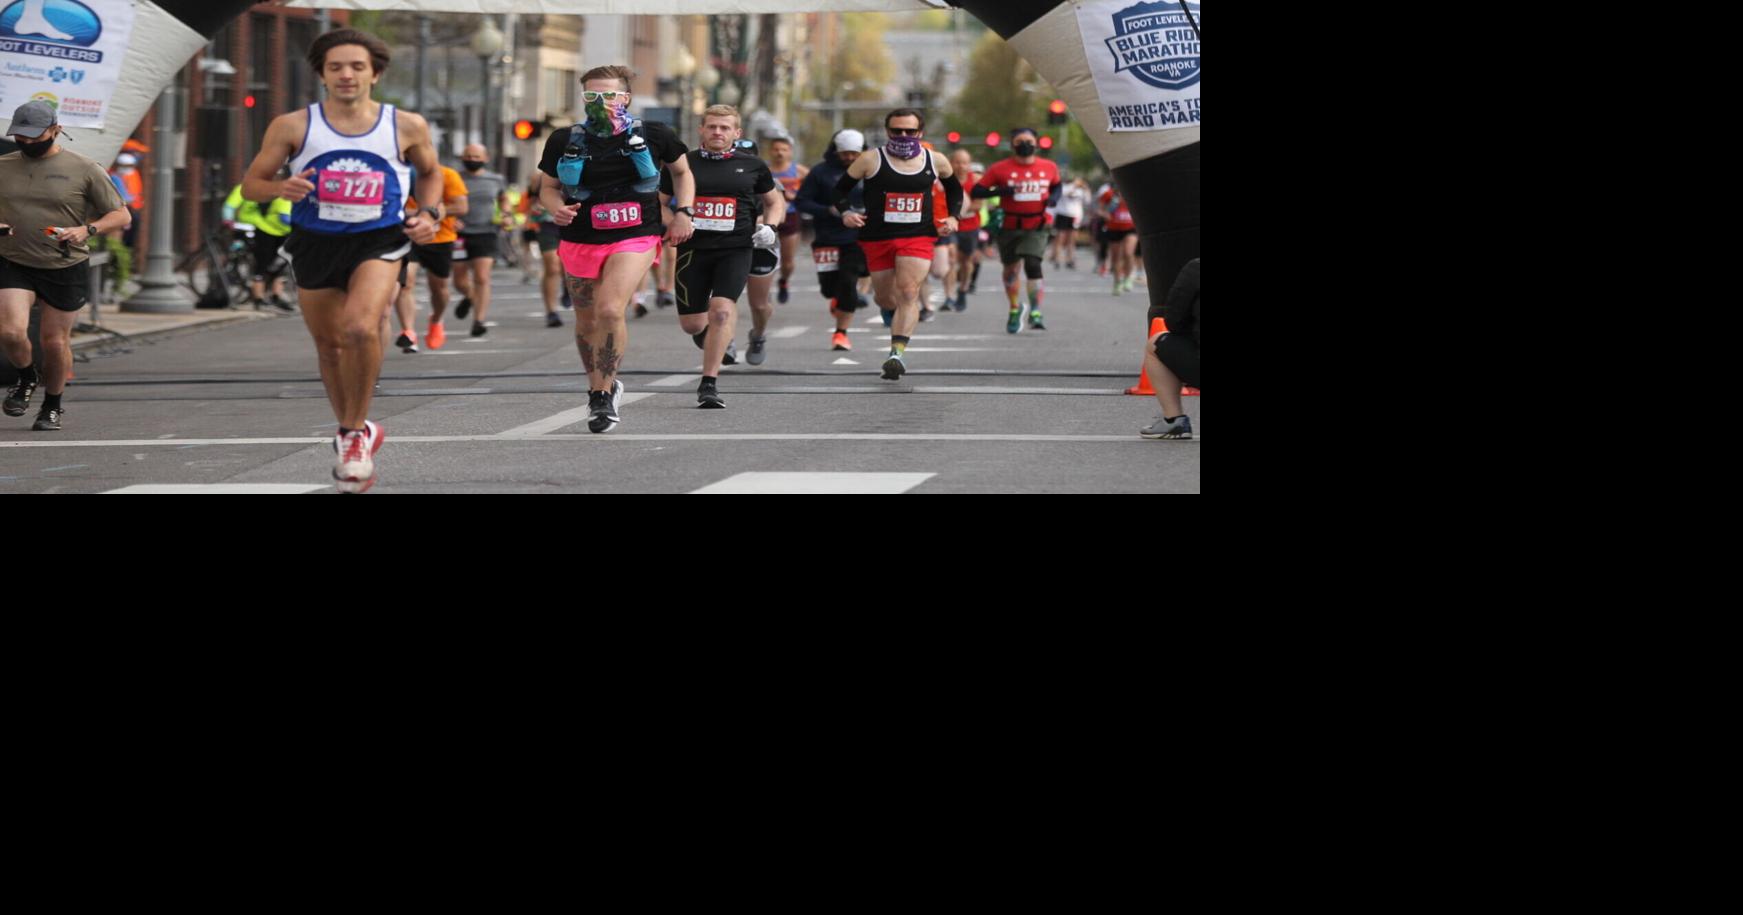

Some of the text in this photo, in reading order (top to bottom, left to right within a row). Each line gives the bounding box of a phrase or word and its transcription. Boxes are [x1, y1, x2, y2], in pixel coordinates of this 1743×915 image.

[1128, 14, 1199, 30] FOOT LEVELES
[1115, 29, 1200, 52] BLUE RID
[24, 43, 98, 60] LEVELERS
[1151, 60, 1196, 73] ROANOKE
[1169, 69, 1180, 77] VA
[1108, 100, 1180, 117] AMERICA'S
[1111, 110, 1200, 128] ROAD MAR
[704, 202, 734, 217] 306
[896, 197, 922, 212] 551
[609, 206, 638, 223] 819
